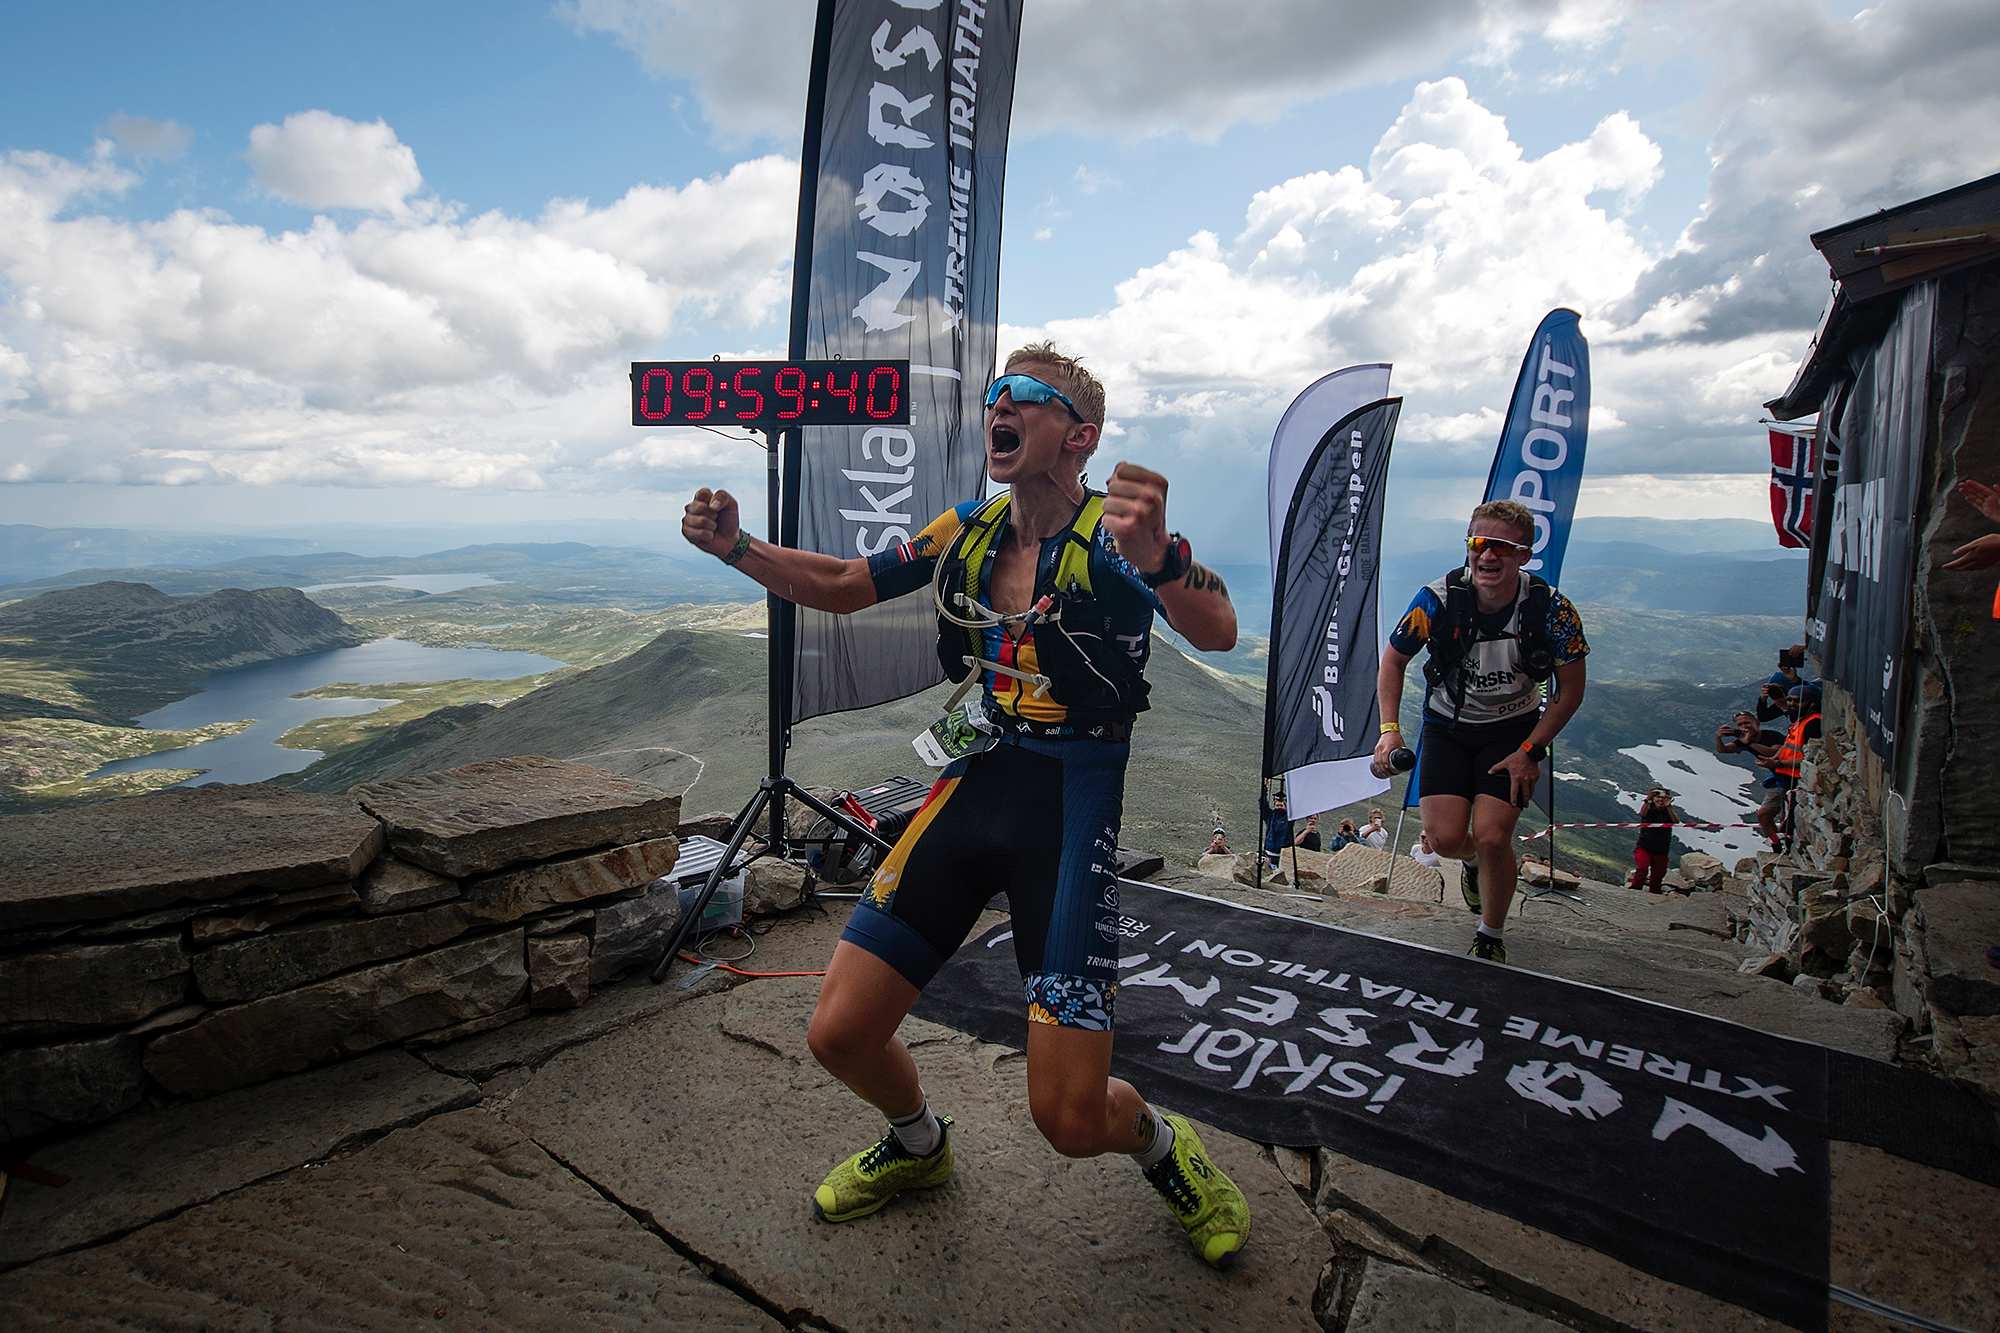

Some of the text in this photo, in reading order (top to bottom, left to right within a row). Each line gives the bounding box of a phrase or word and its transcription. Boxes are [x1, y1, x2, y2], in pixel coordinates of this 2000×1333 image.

[852, 0, 943, 333] NORS
[942, 0, 986, 342] XTREME TRIATH
[640, 366, 900, 419] 09:59:40
[1509, 345, 1575, 572] PORT
[838, 416, 917, 557] skla
[1330, 437, 1349, 548] BAKERIES
[1157, 1021, 1407, 1110] isklar
[1180, 939, 1794, 1111] XTREME TRIATHLON
